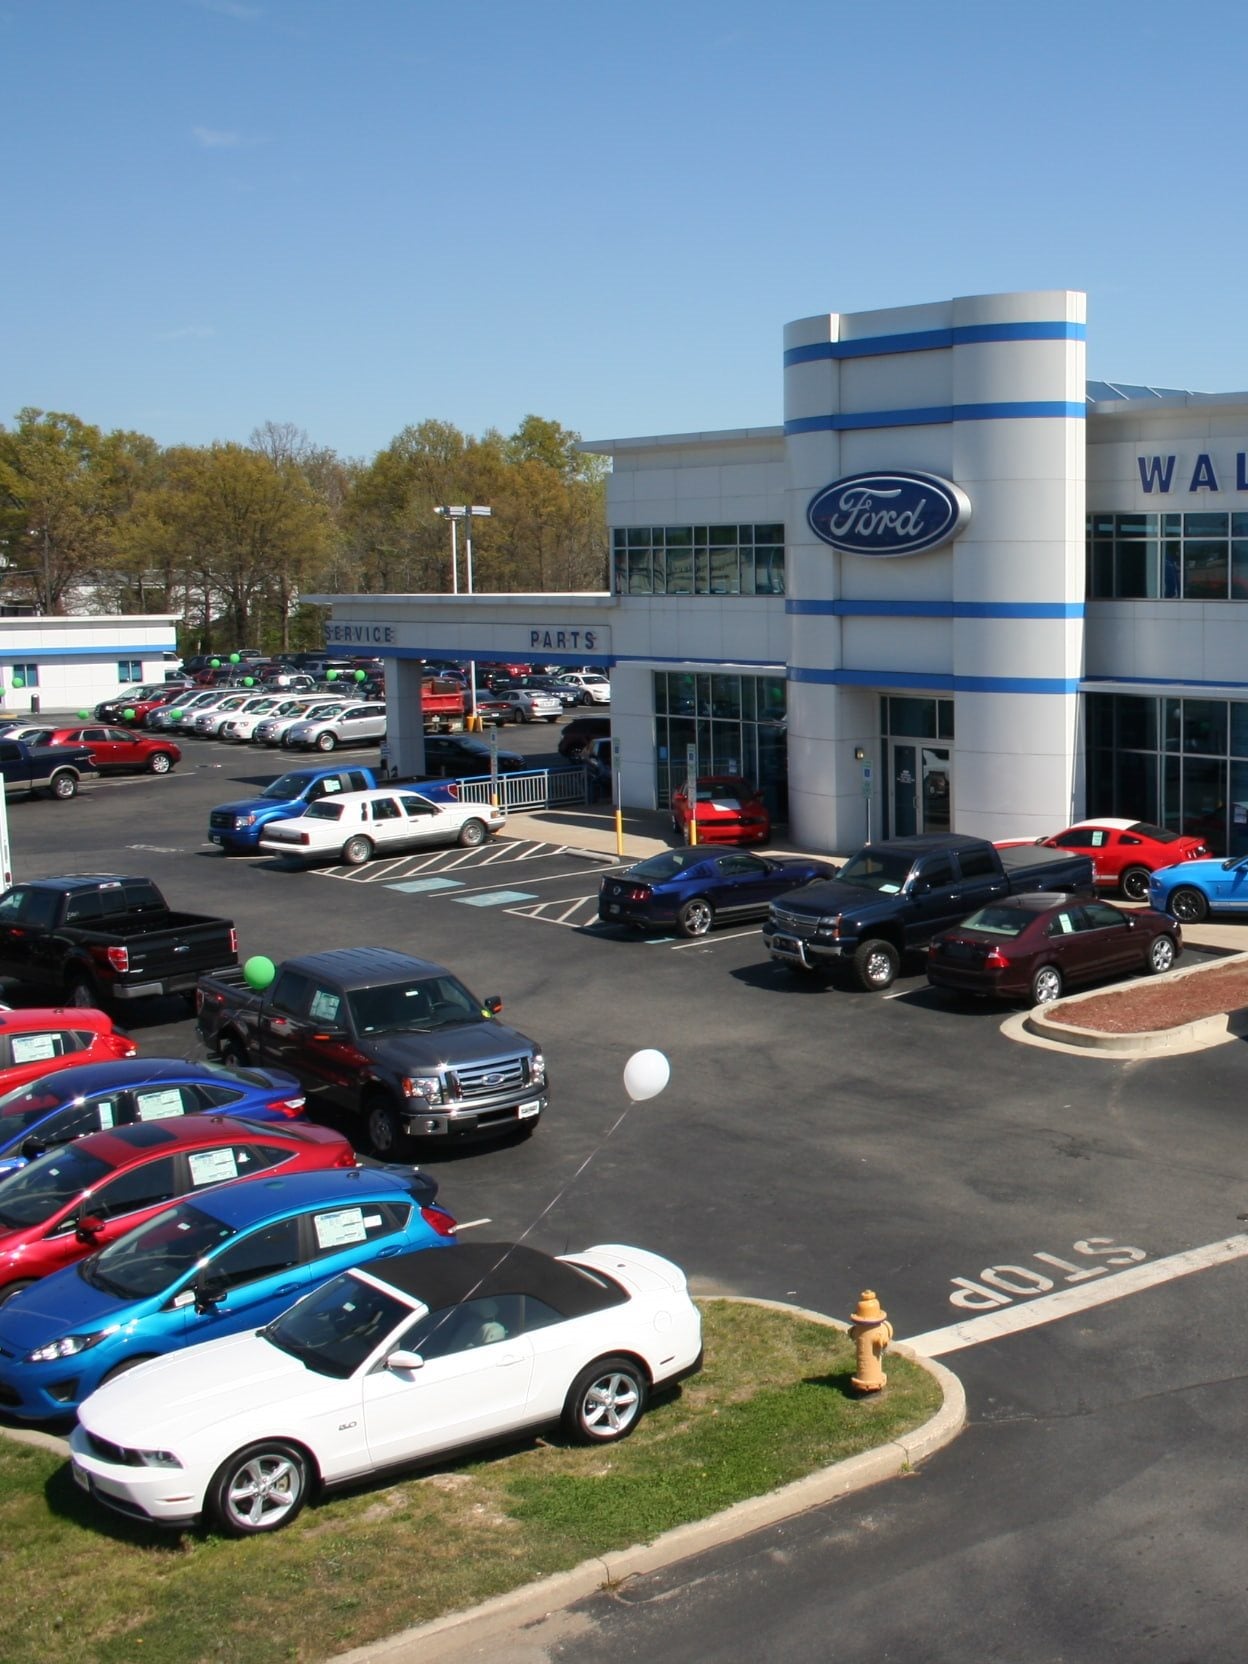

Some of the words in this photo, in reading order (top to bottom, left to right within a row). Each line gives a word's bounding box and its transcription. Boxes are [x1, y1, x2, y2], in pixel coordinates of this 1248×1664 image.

[830, 487, 927, 537] Ford
[325, 625, 394, 643] SERVICE
[530, 630, 596, 650] PARTS
[949, 1237, 1147, 1310] STOP
